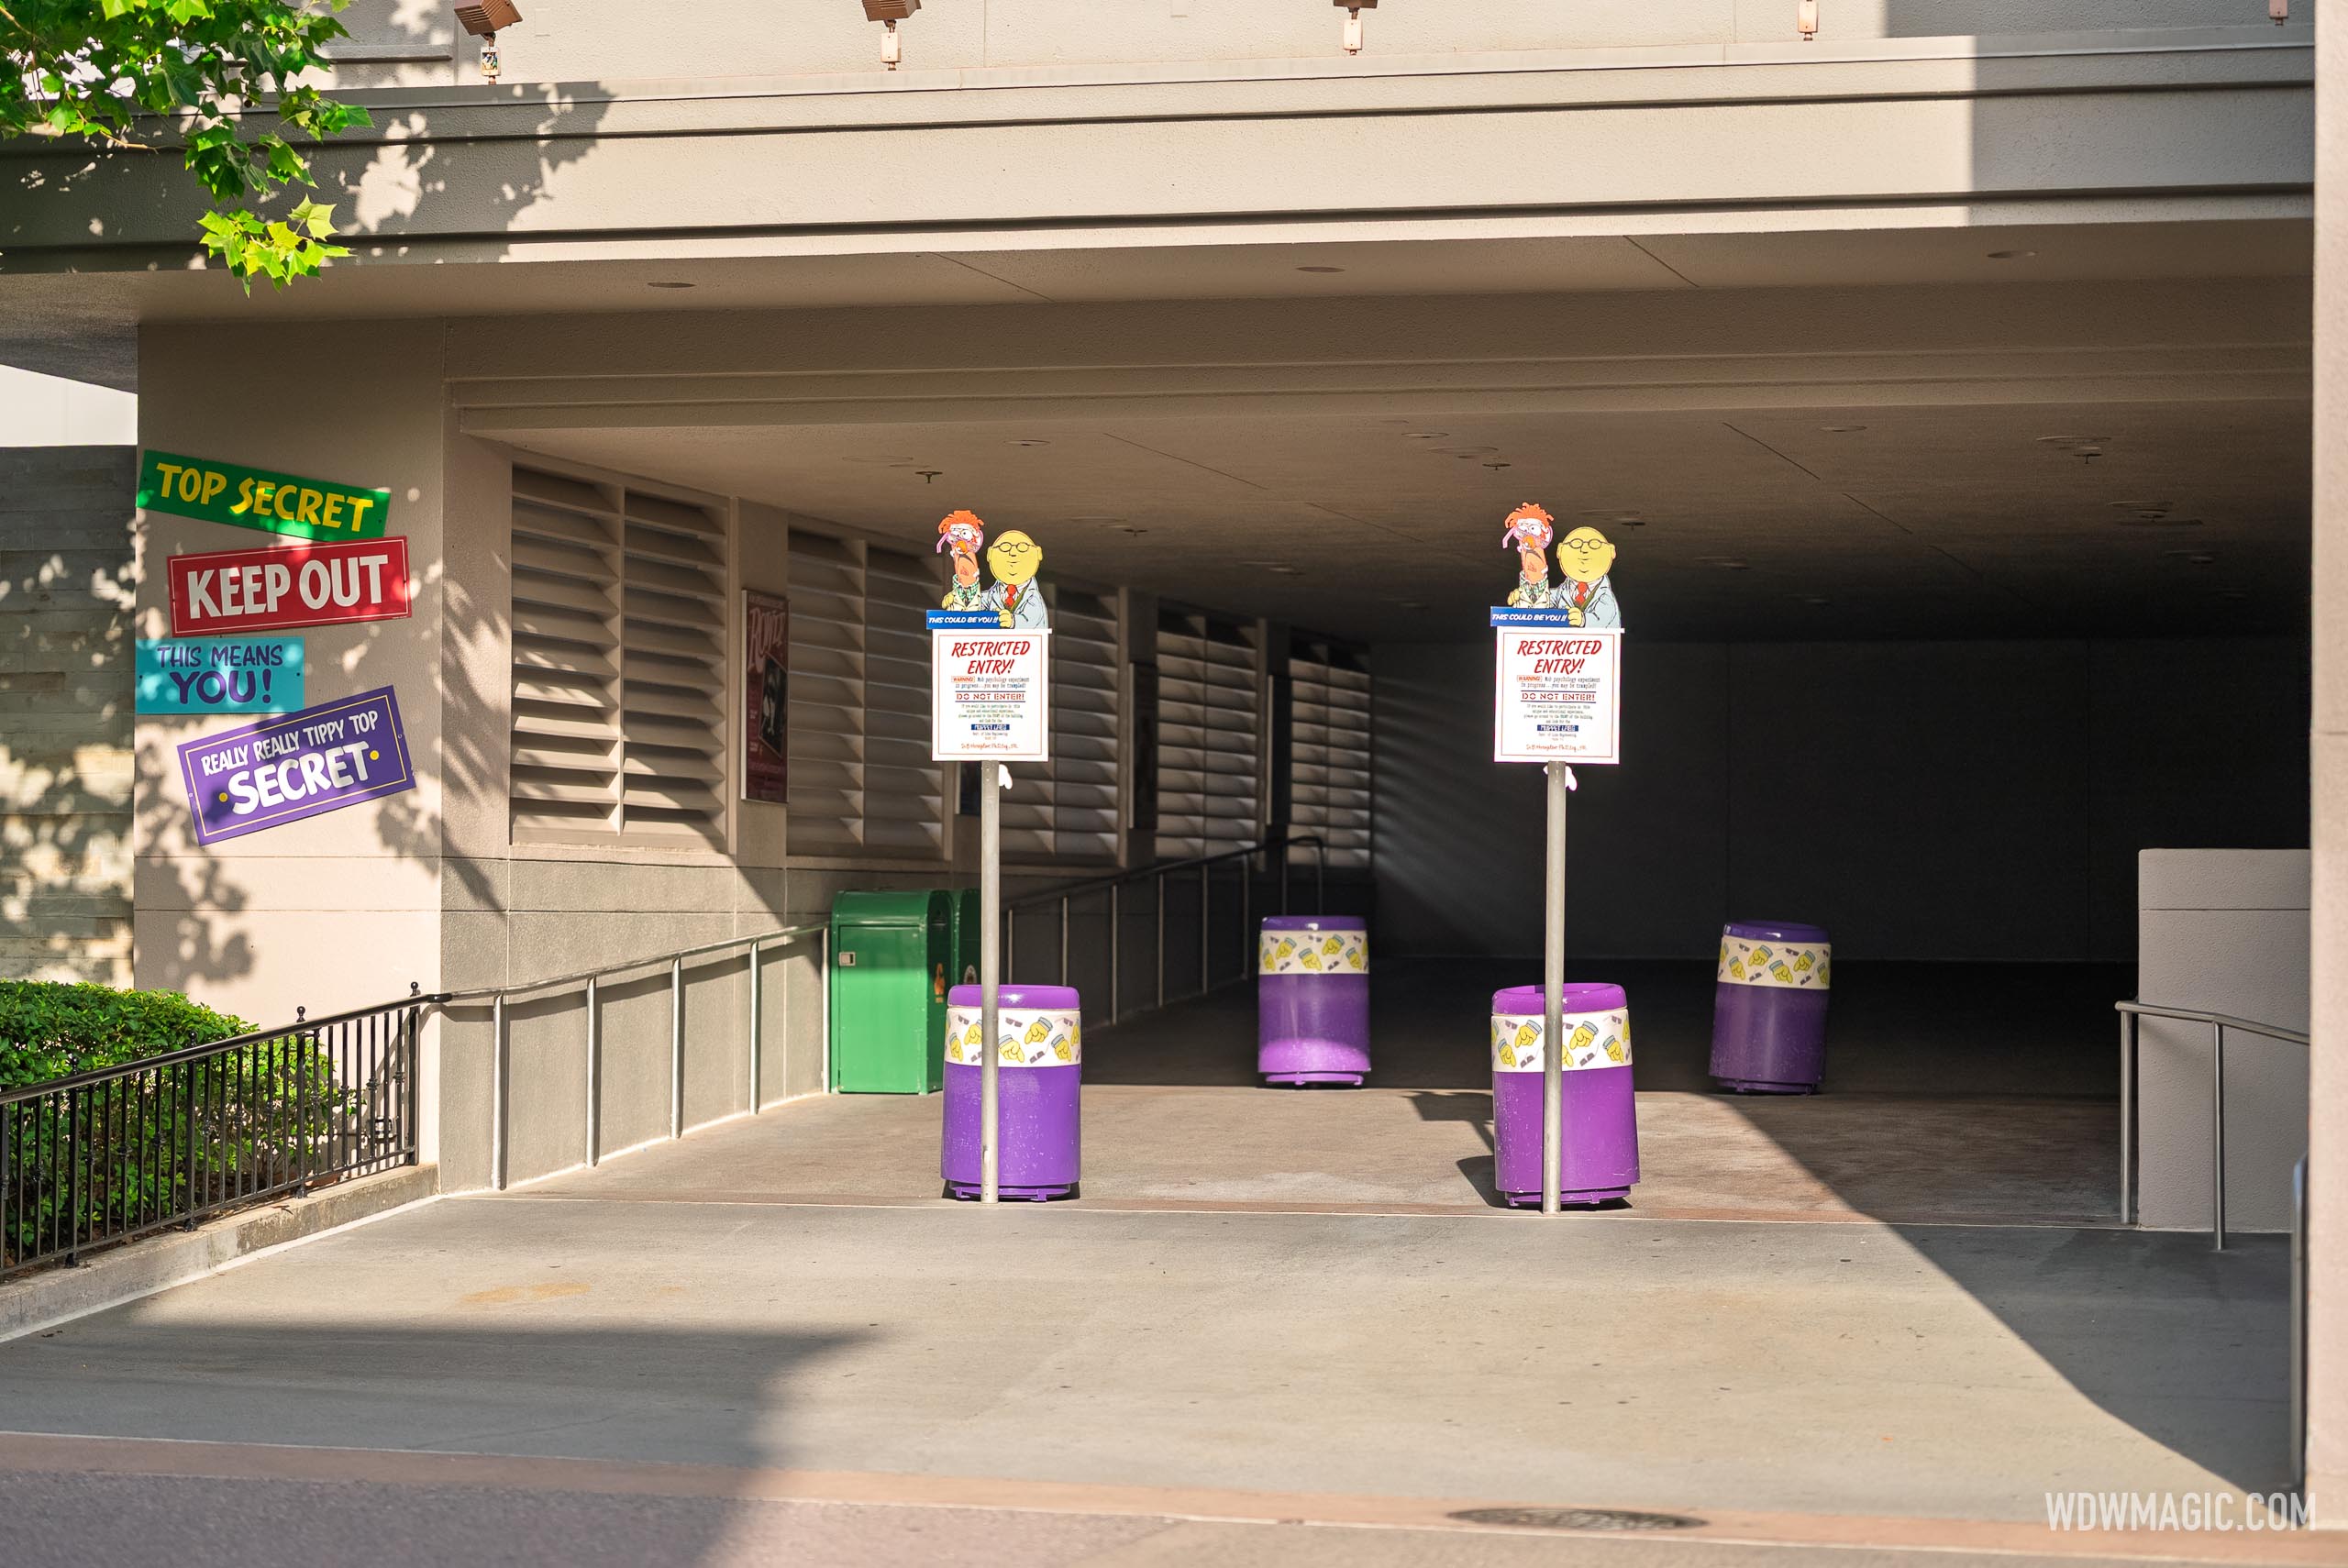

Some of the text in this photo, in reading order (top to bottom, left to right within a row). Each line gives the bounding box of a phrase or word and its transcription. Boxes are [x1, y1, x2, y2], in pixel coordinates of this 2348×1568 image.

[156, 462, 374, 532] TOP SECRET
[187, 554, 388, 619] KEEP OUT
[157, 645, 283, 668] THIS MEANS
[951, 640, 1031, 657] RESTRICTED
[1517, 639, 1602, 657] RESTRICTED
[968, 658, 1015, 675] ENTRY!
[1534, 657, 1586, 675] ENTRY!
[170, 668, 271, 704] YOU!
[1522, 692, 1536, 701] DO
[1562, 693, 1595, 701] ENTER!
[201, 710, 379, 777] REALLY REALLY TIPPY TOP
[228, 741, 370, 815] SECRET
